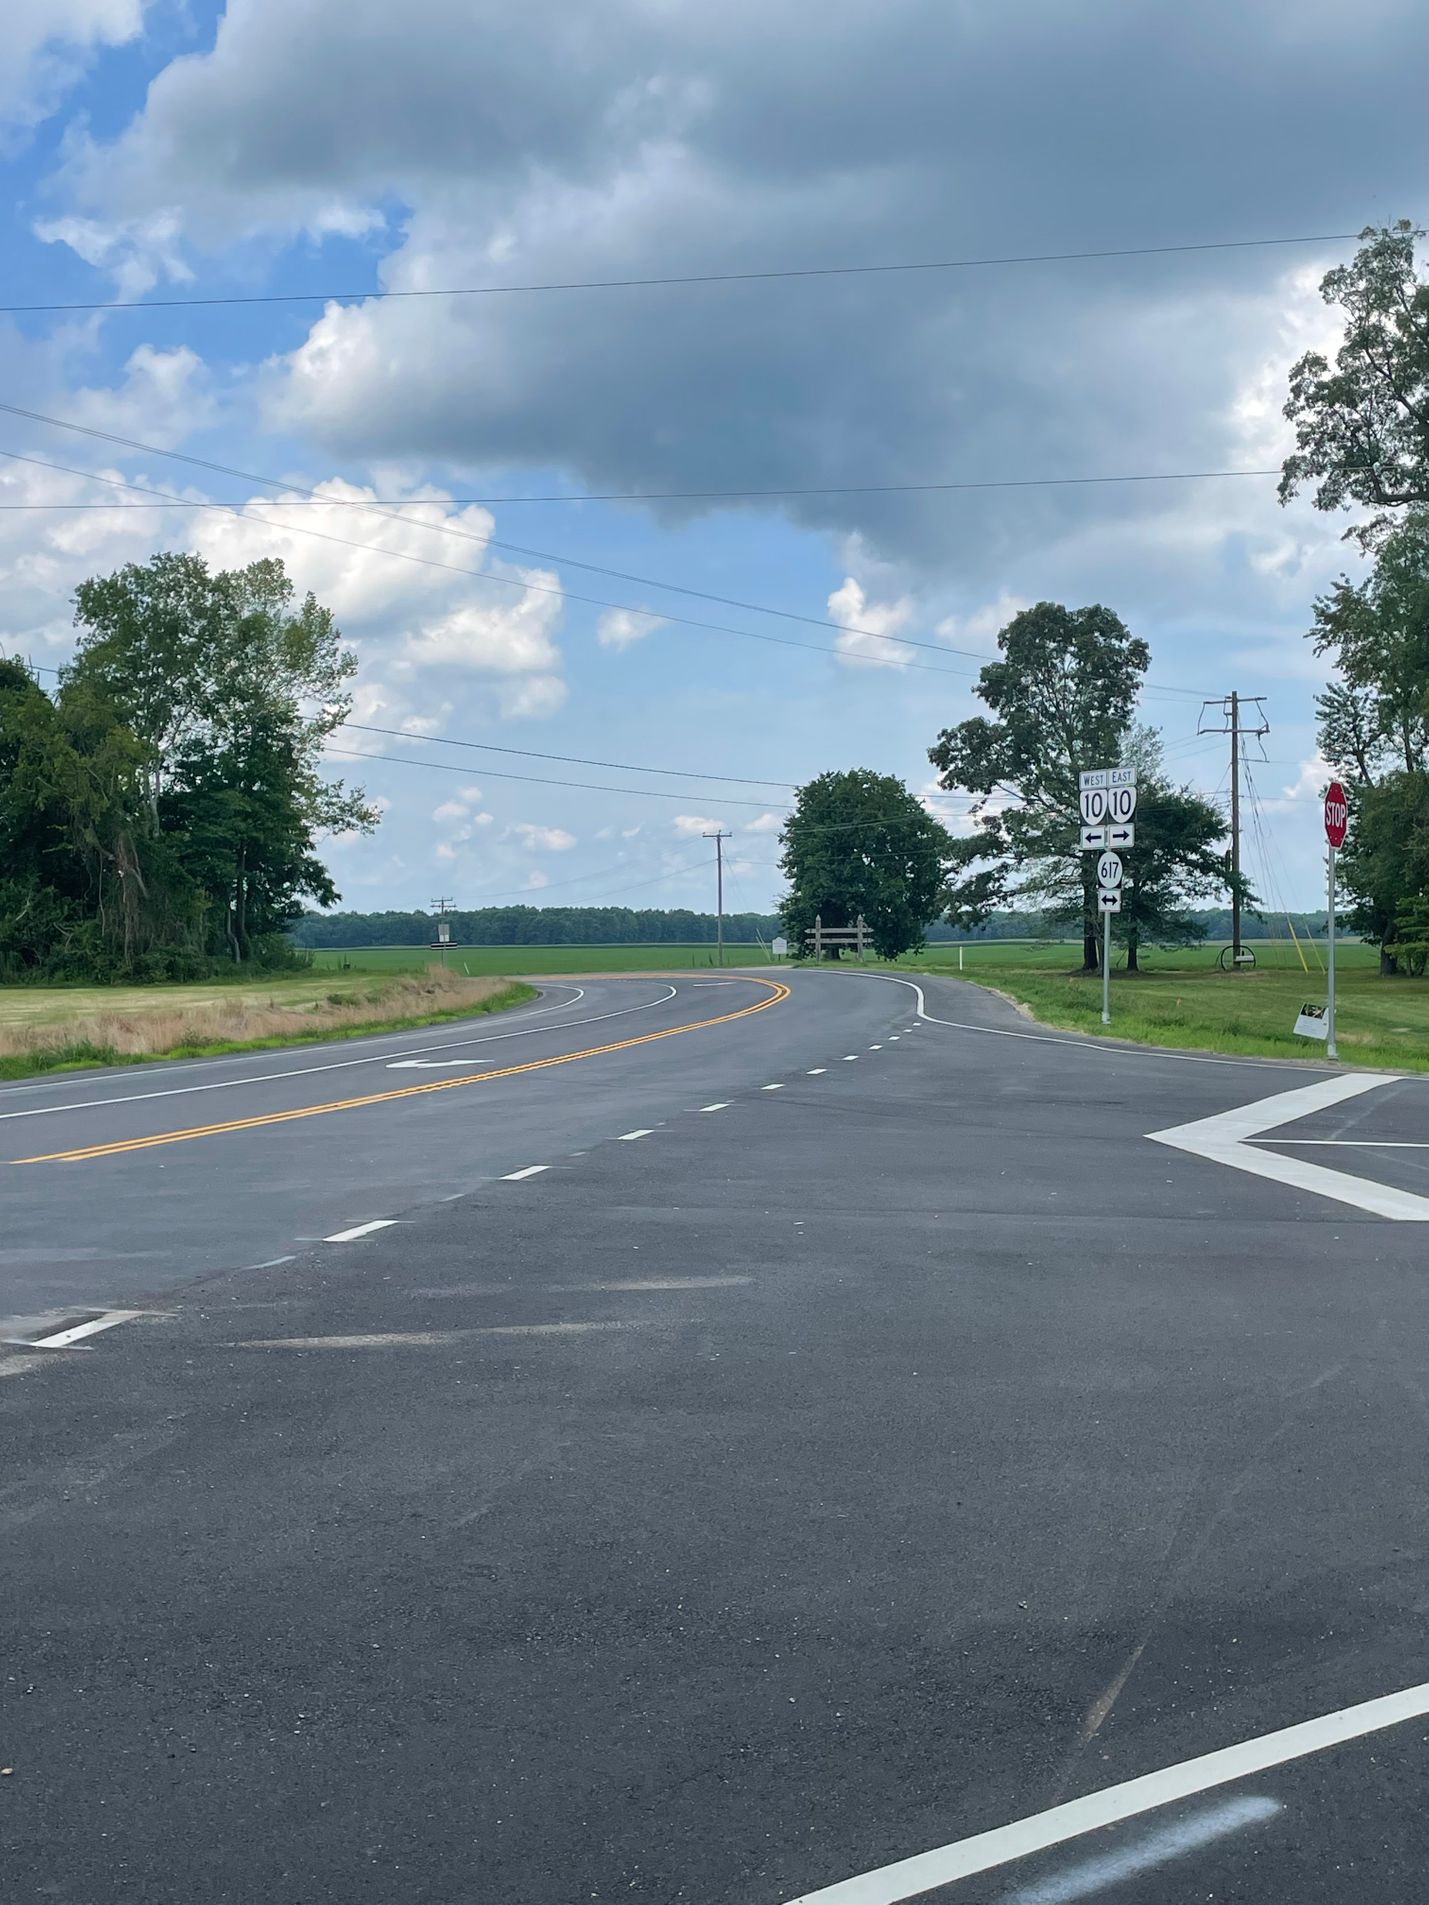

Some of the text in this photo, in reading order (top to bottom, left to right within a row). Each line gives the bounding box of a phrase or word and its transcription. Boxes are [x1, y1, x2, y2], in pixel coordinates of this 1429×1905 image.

[1083, 774, 1104, 786] WEST
[1112, 771, 1132, 783] EAST
[1085, 793, 1103, 818] 10
[1113, 790, 1131, 815] 10
[1326, 801, 1346, 828] STOP
[1101, 862, 1119, 878] 617
